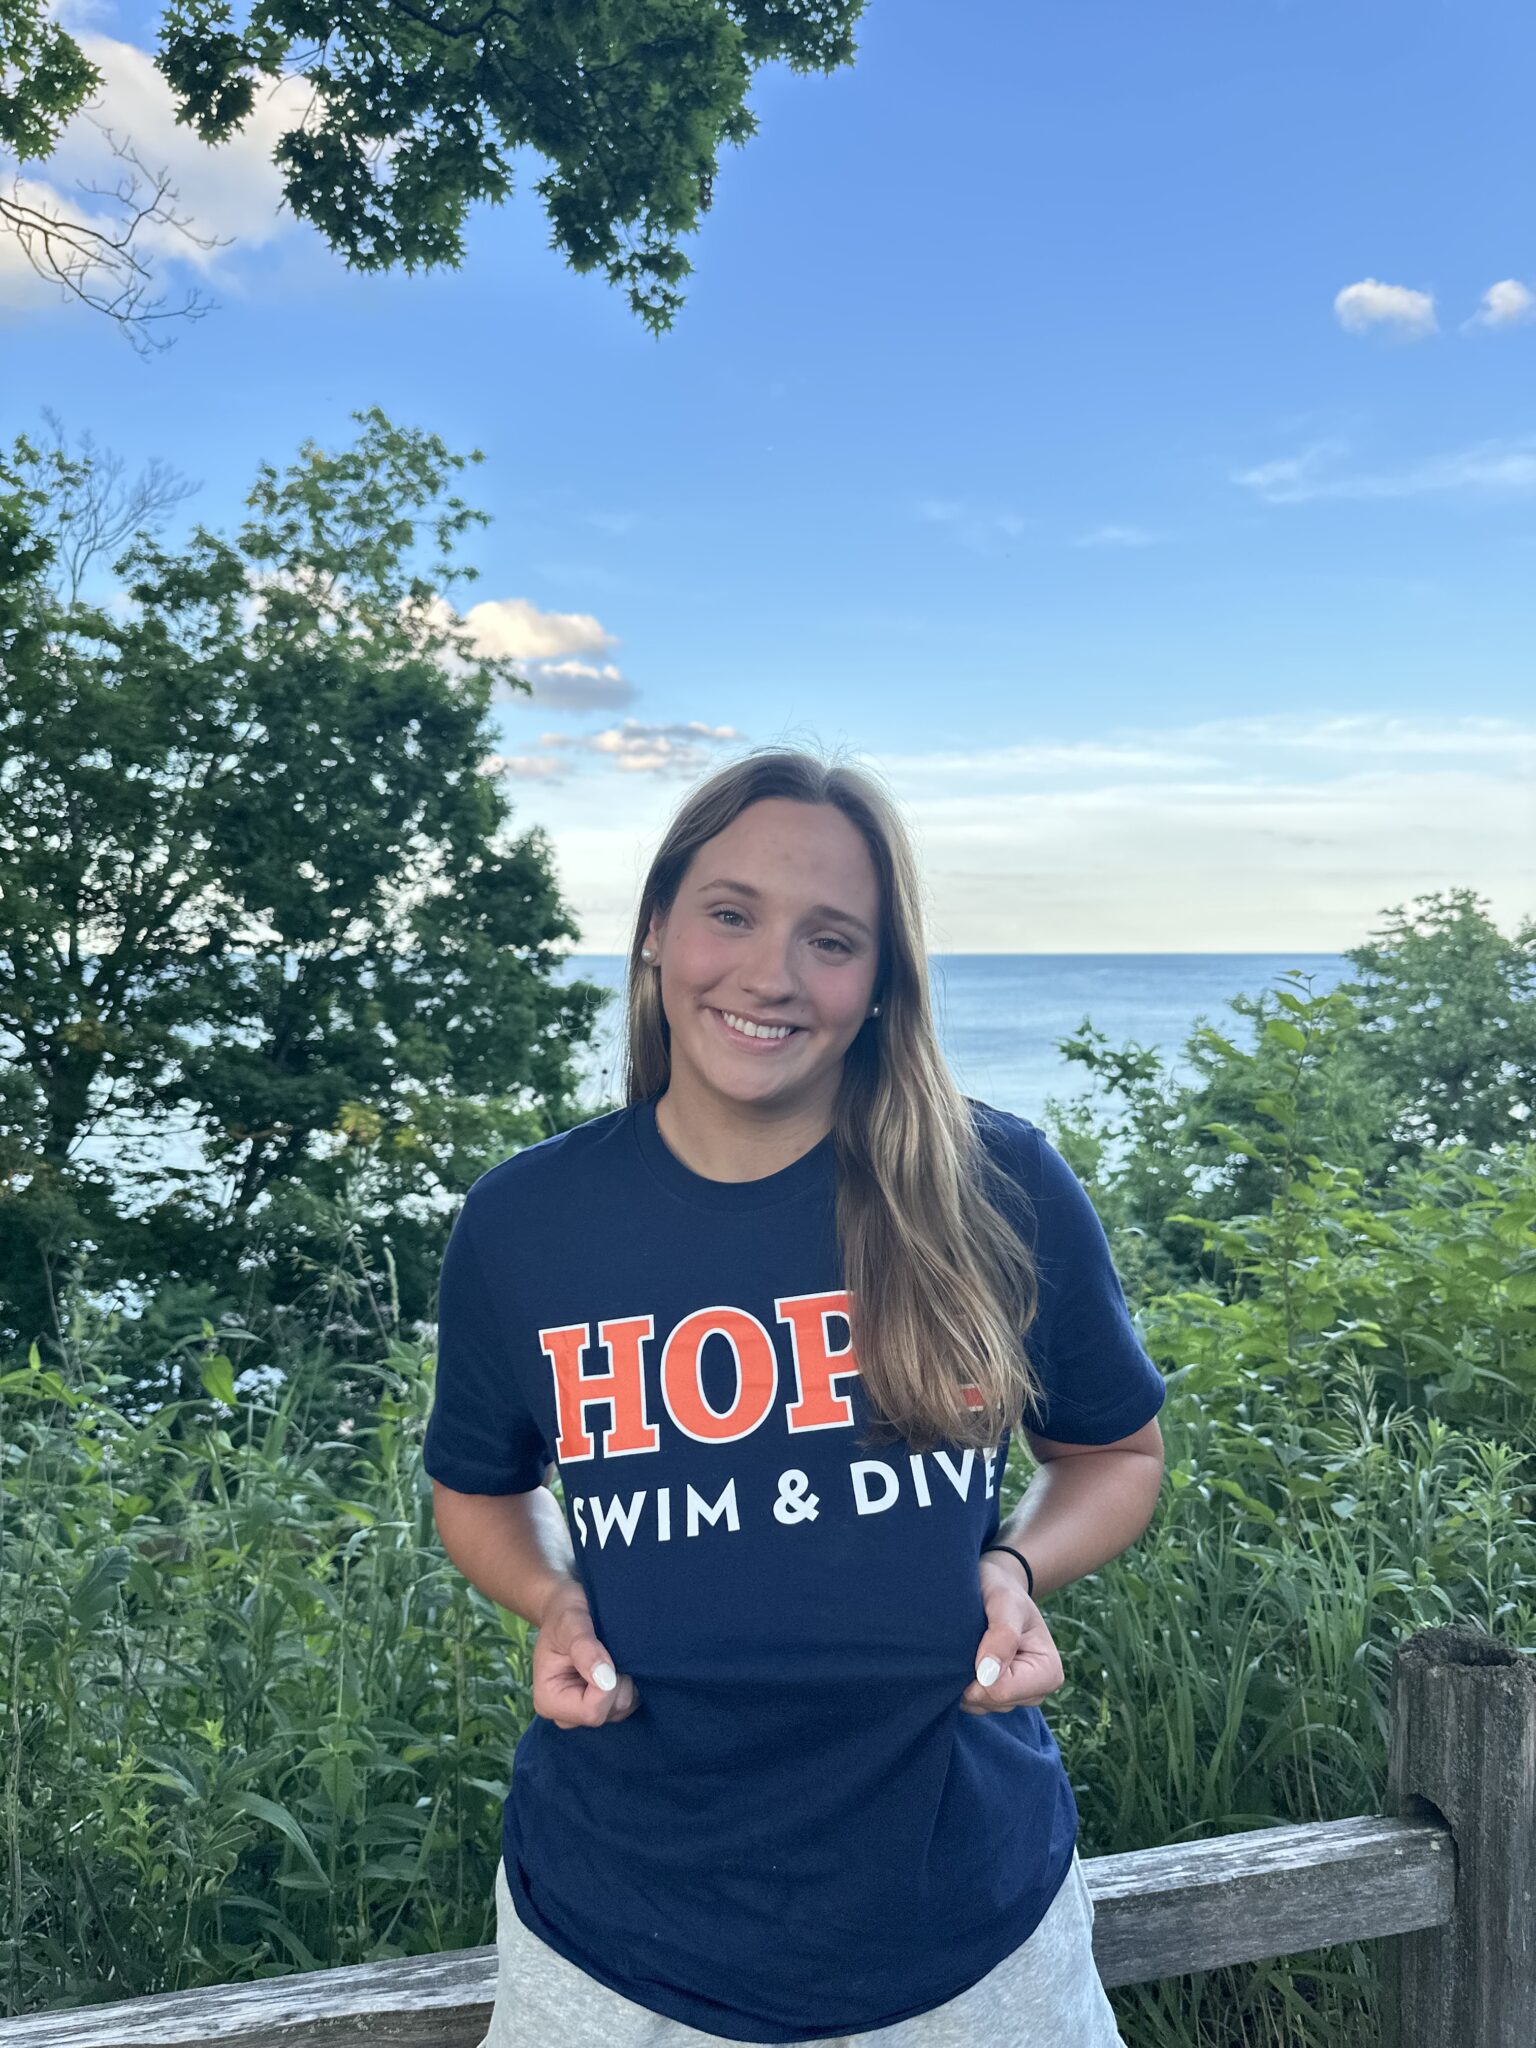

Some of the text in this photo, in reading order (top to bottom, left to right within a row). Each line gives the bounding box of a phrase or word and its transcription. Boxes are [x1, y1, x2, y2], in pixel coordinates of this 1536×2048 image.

[538, 1290, 1000, 1464] HOP
[573, 1448, 998, 1550] SWIM & DIVE
